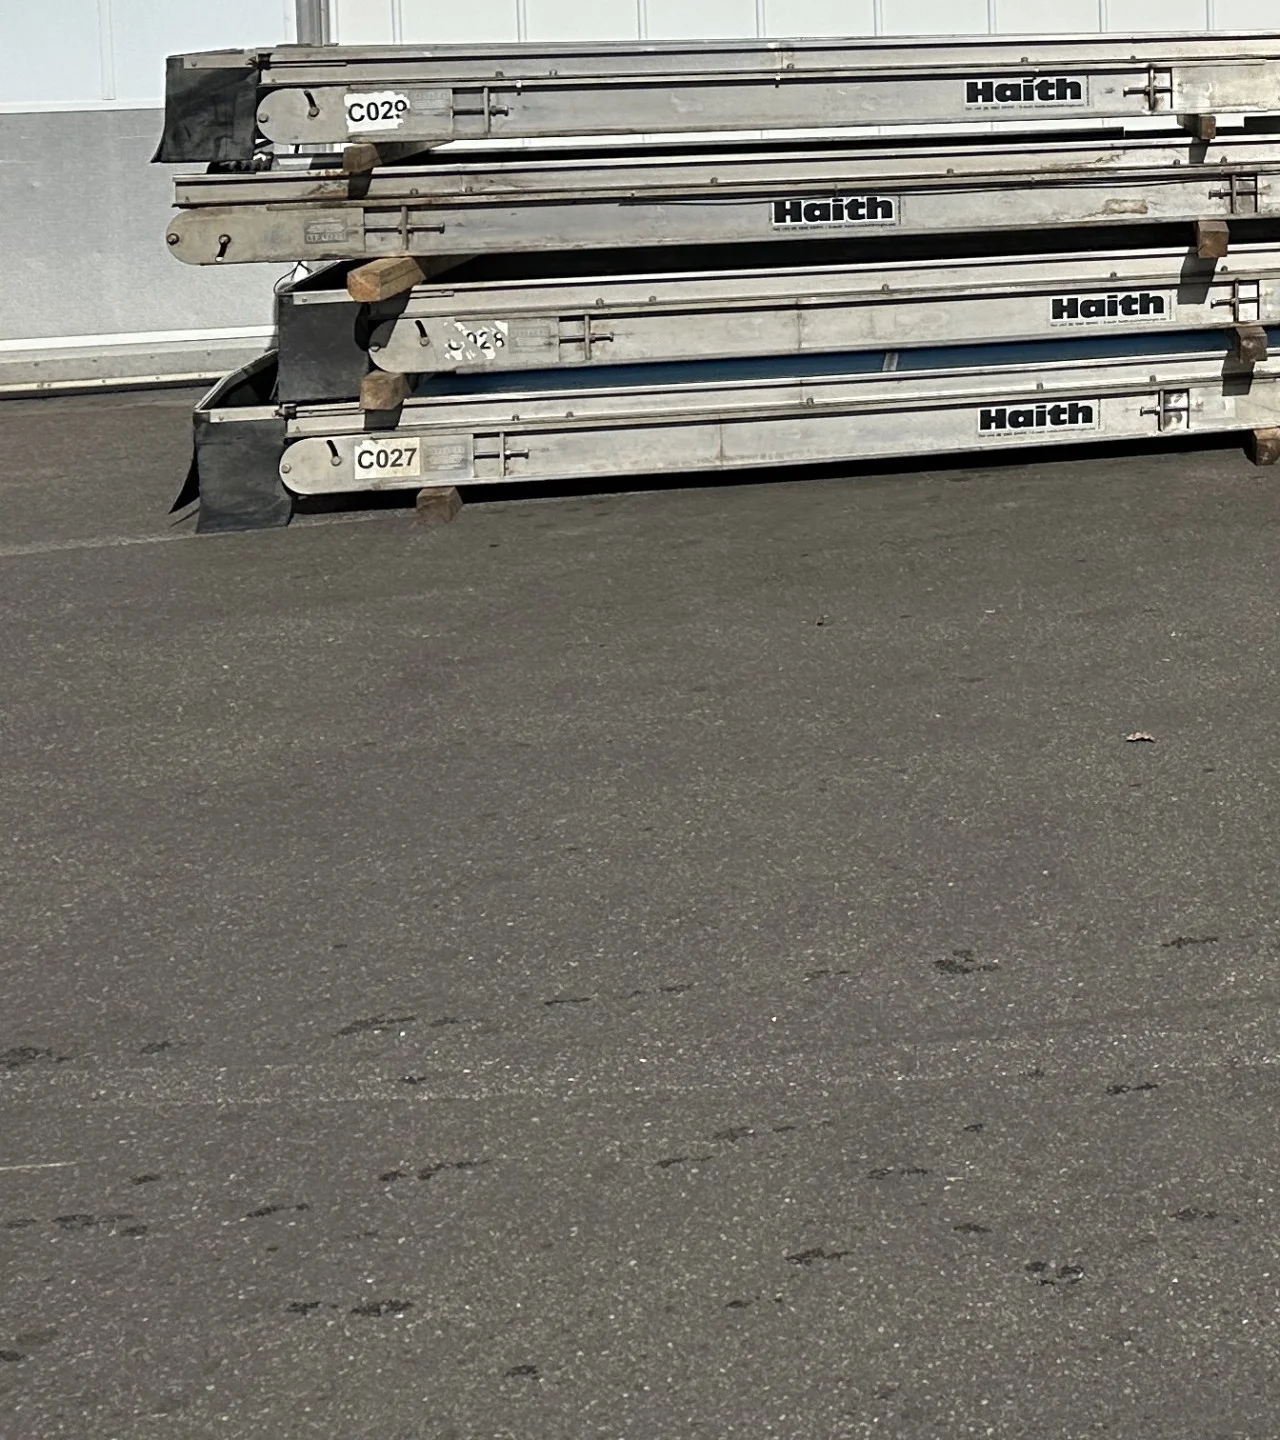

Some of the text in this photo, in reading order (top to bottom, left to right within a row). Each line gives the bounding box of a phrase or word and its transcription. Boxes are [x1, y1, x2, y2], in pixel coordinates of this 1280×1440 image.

[966, 78, 1082, 103] Haith
[348, 100, 407, 122] C029
[773, 197, 893, 223] Haith
[1051, 293, 1165, 319] Haith
[979, 403, 1093, 430] Haith
[357, 448, 418, 469] C027
